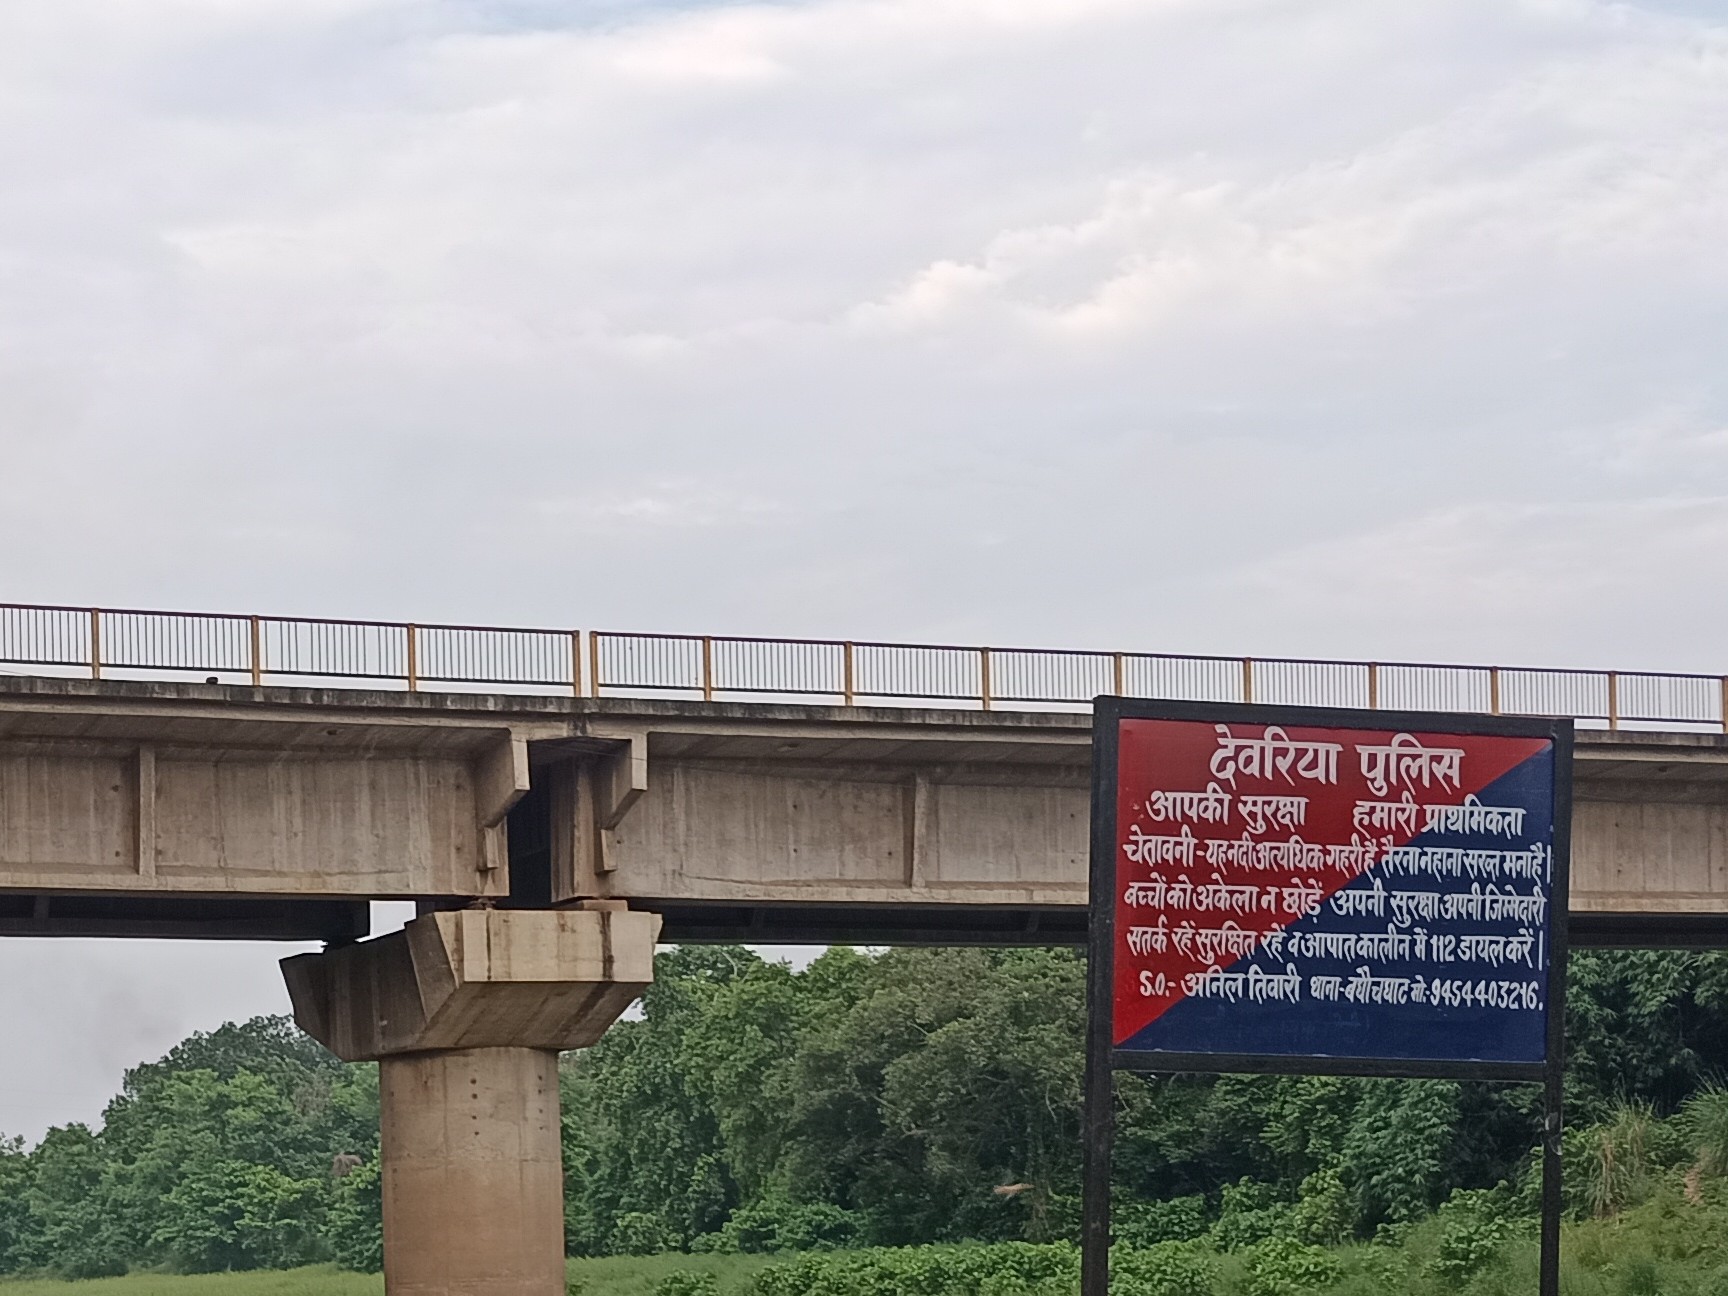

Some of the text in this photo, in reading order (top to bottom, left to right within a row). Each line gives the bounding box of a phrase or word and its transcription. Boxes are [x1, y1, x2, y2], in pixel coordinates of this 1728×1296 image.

[1210, 724, 1465, 797] देवरिया पुलिस
[1145, 781, 1528, 840] आपकी सुरक्षा हमारी प्राथमिकता
[1226, 831, 1256, 873] नदी
[1252, 834, 1325, 873] अत्यधिक
[1325, 832, 1366, 880] गहरी
[1379, 834, 1422, 879] तैरना
[1419, 847, 1466, 883] नहाना
[1502, 850, 1533, 880] मना
[1123, 871, 1548, 928] बच्चों को अकेला न छोड़ें अपनी सुरक्षा अपनी जिम्मेदारी
[1126, 913, 1170, 957] सतर्क
[1170, 919, 1197, 962] रहें
[1194, 920, 1259, 966] सुरक्षित
[1260, 921, 1288, 964] रहें
[1287, 931, 1303, 958] व
[1412, 926, 1429, 962] में
[1429, 934, 1456, 963] 112
[1457, 935, 1508, 968] डायल
[1179, 964, 1247, 1005] अनिल
[1246, 963, 1303, 1005] तिवारी
